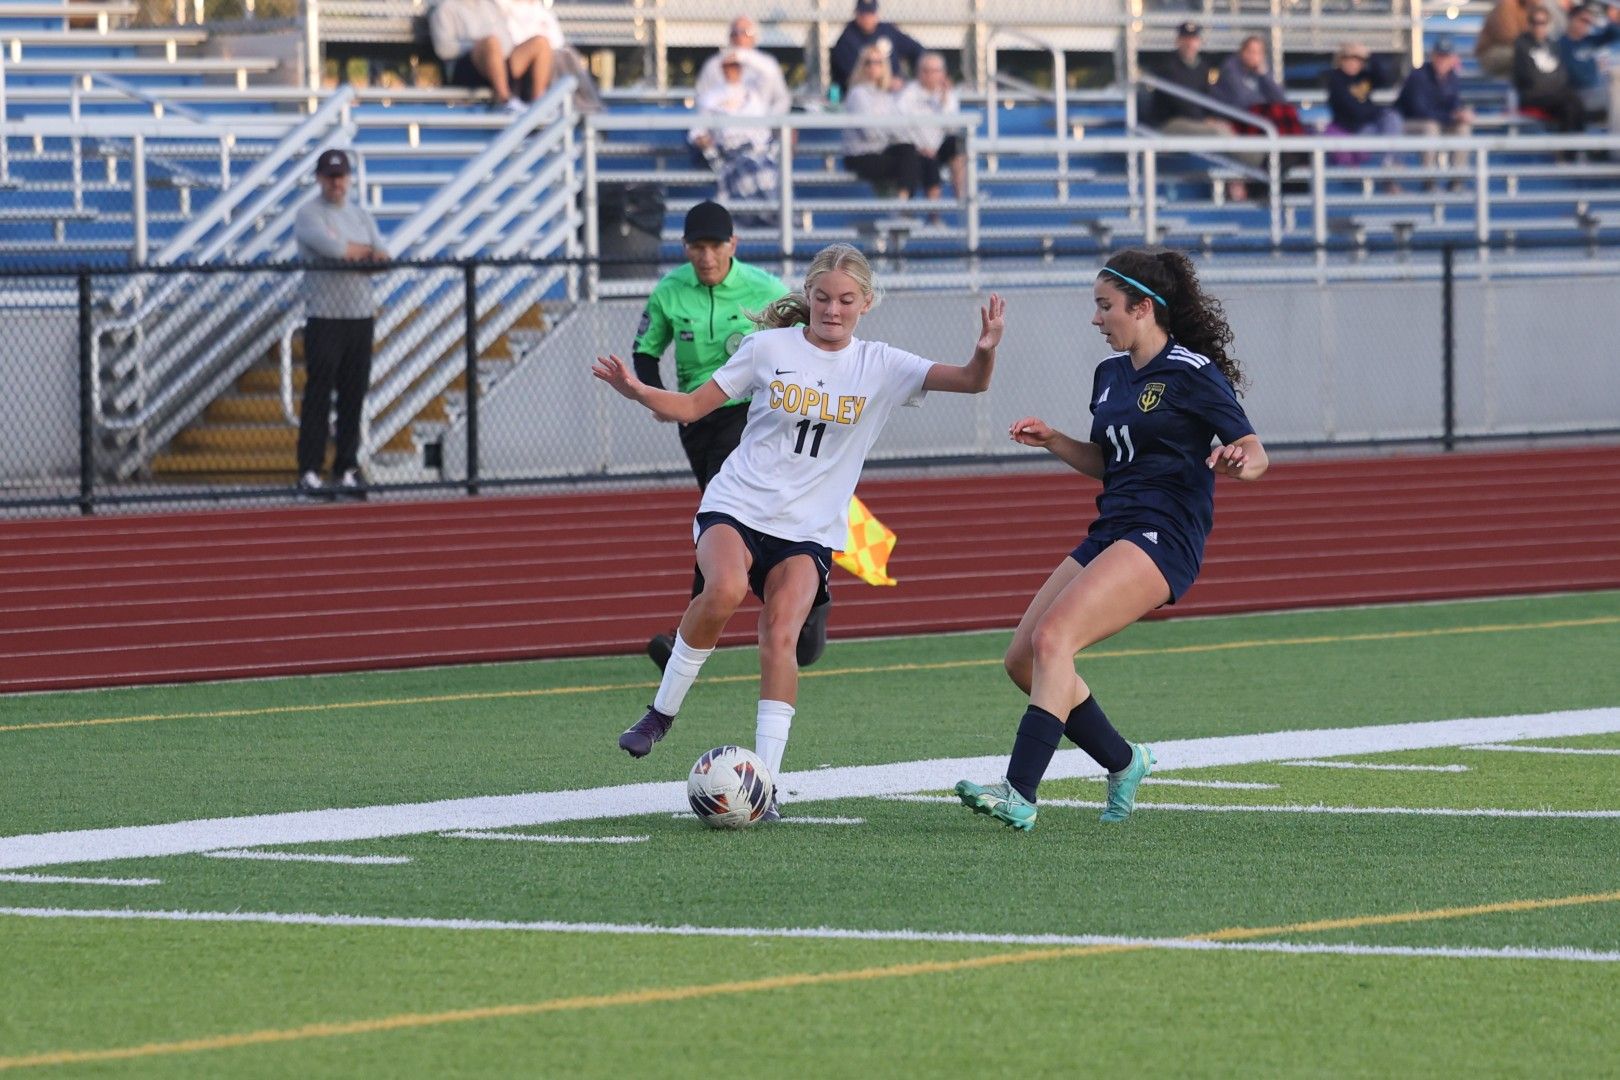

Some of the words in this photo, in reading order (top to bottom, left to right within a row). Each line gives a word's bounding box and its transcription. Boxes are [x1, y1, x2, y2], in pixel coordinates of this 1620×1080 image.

[769, 380, 867, 424] COPLEY
[794, 418, 827, 458] 11
[1105, 424, 1135, 462] 11
